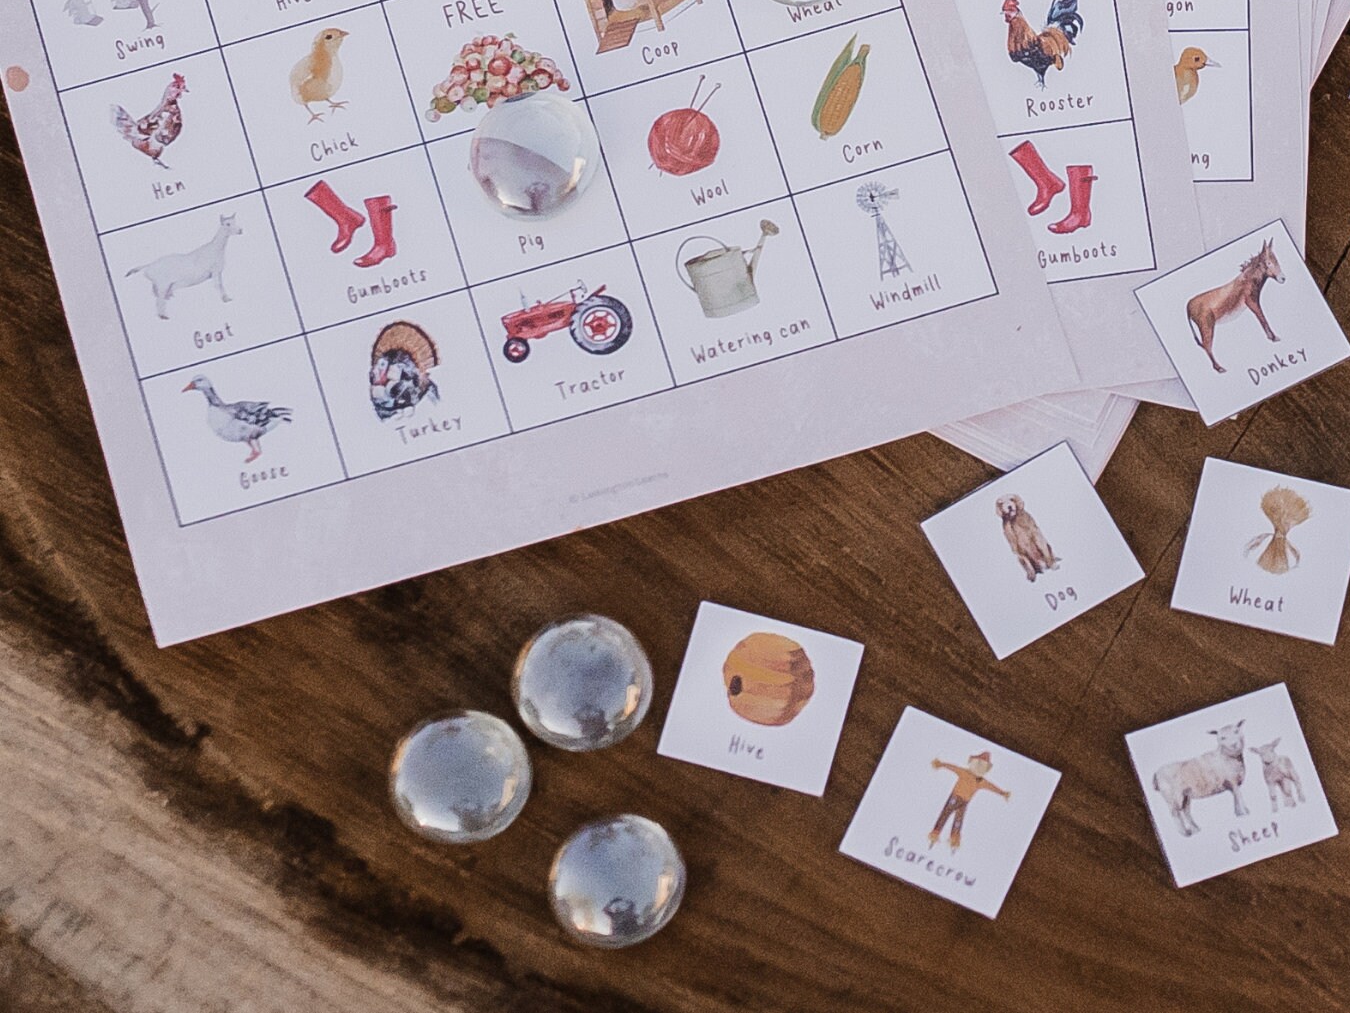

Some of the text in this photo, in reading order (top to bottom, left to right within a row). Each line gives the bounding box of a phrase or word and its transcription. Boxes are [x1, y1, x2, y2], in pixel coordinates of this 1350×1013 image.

[116, 35, 165, 60] Swing
[642, 42, 678, 65] Coop
[1026, 94, 1093, 117] Rooster
[311, 134, 358, 163] Chick
[843, 140, 883, 163] Corn
[152, 181, 185, 199] Hen
[691, 179, 728, 205] Wool
[518, 236, 544, 254] Pig
[1038, 242, 1116, 268] Gumboots
[348, 269, 428, 304] Gumboots
[870, 275, 943, 312] Windmill
[194, 323, 233, 349] Goat
[691, 320, 810, 367] Watering can
[1248, 348, 1312, 389] Donkey
[554, 370, 624, 399] Tractor
[396, 418, 461, 445] Turkey
[240, 465, 289, 490] Goose
[1045, 587, 1077, 611] Dog
[1230, 586, 1283, 612] Wheat
[729, 735, 763, 760] Hive
[1229, 822, 1283, 856] Sheep
[885, 836, 977, 888] Scarecrow
